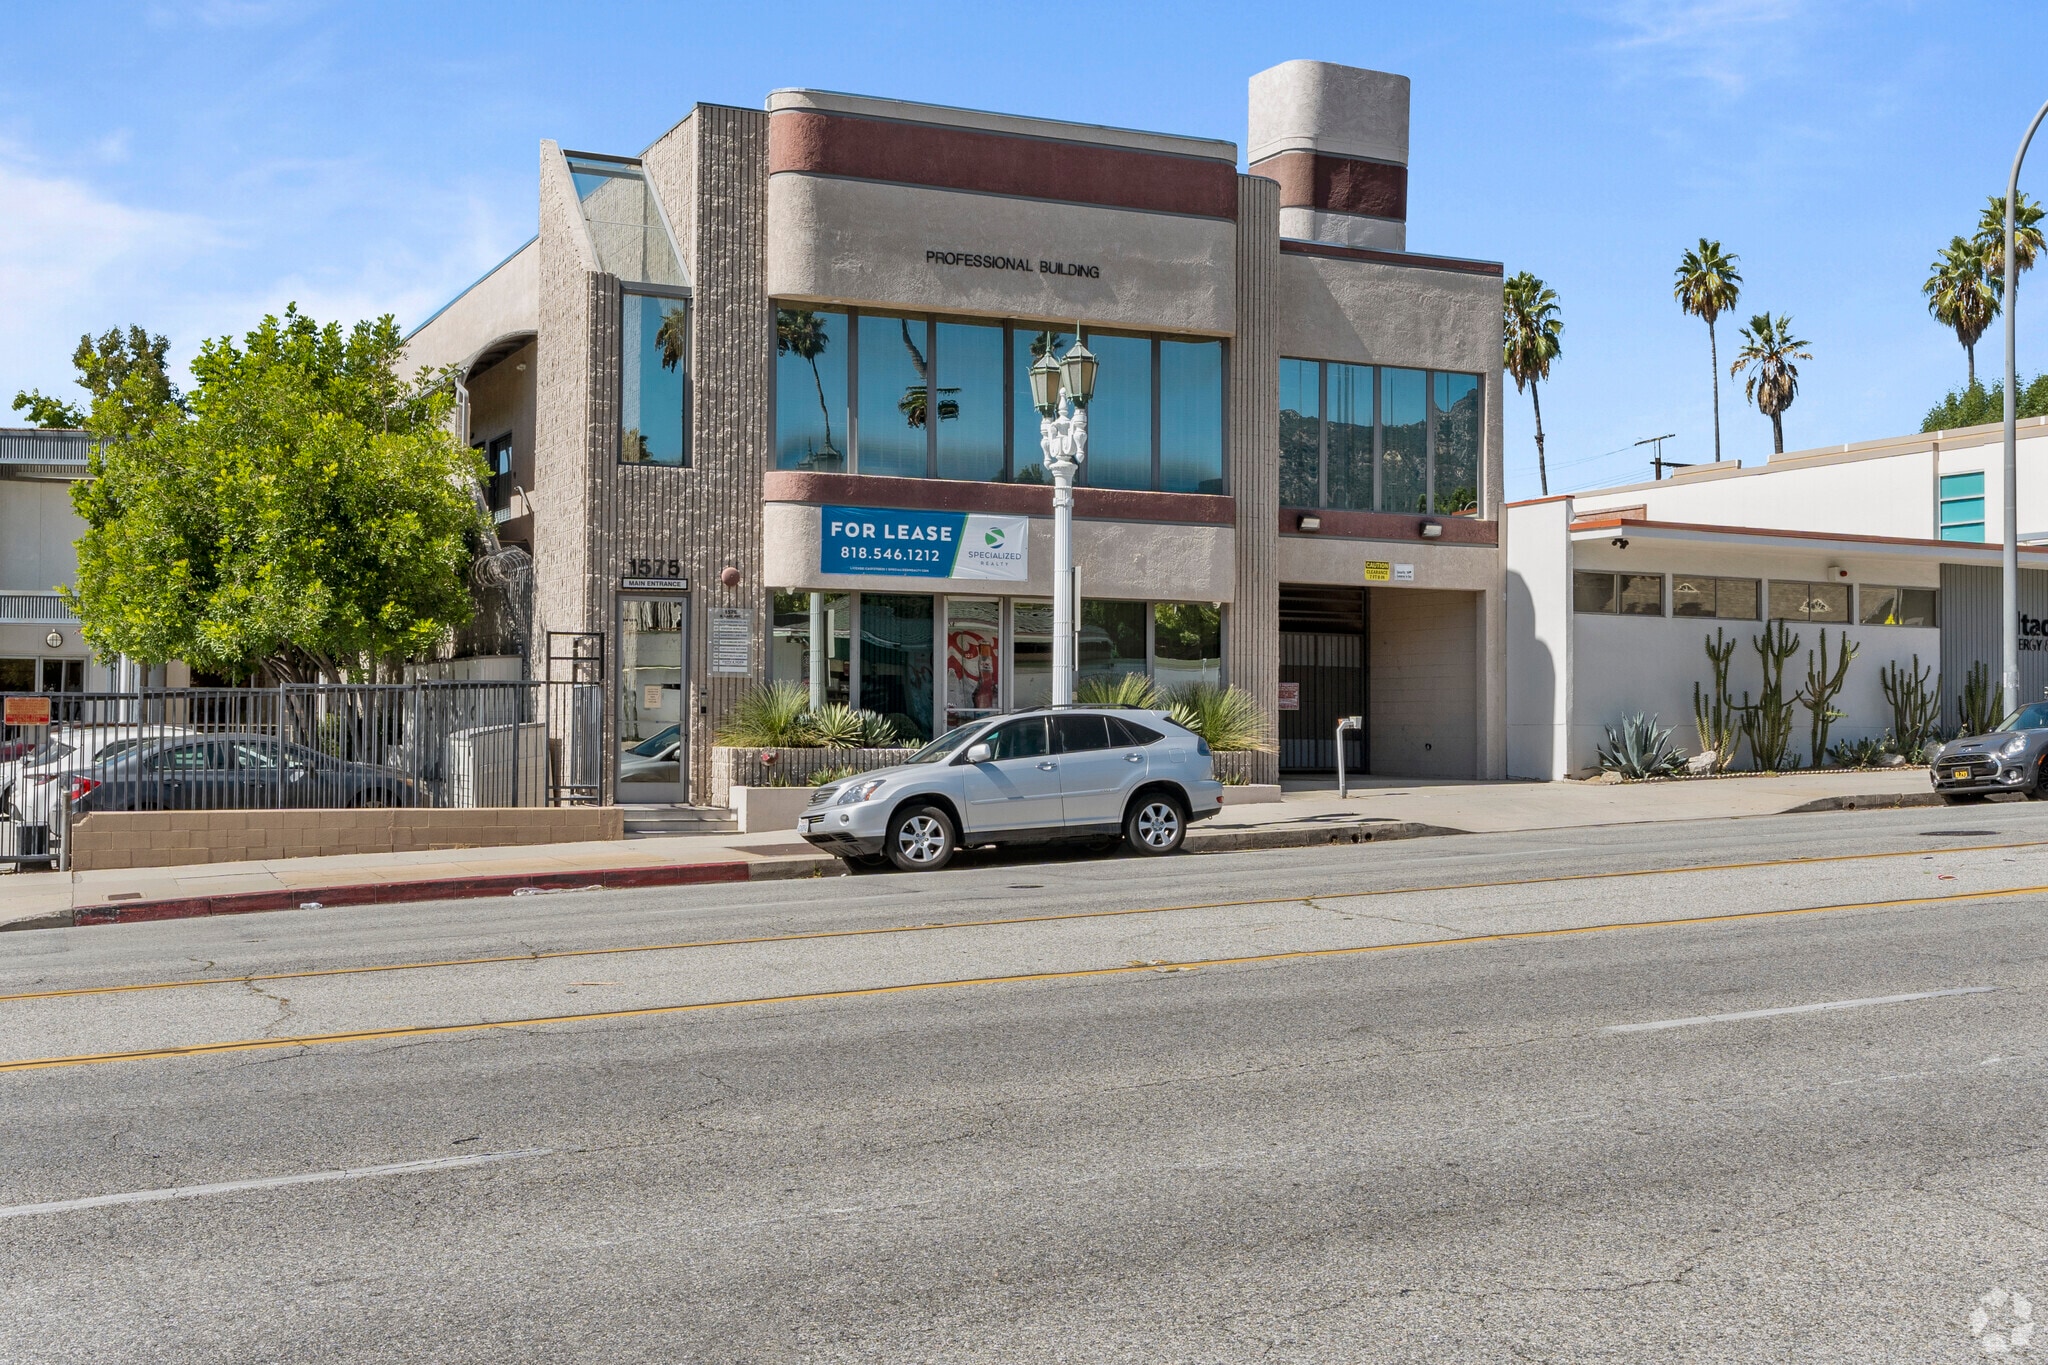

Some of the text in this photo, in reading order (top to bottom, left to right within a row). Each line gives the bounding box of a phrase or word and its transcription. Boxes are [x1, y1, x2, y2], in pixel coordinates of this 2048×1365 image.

[926, 250, 1100, 279] PROFESSIONAL BUILDING
[831, 521, 952, 541] FOR LEASE
[841, 546, 940, 562] 818.546.1212
[968, 550, 1022, 560] SPECIALIZED
[628, 558, 680, 577] 1575
[1366, 561, 1389, 569] CAUTION
